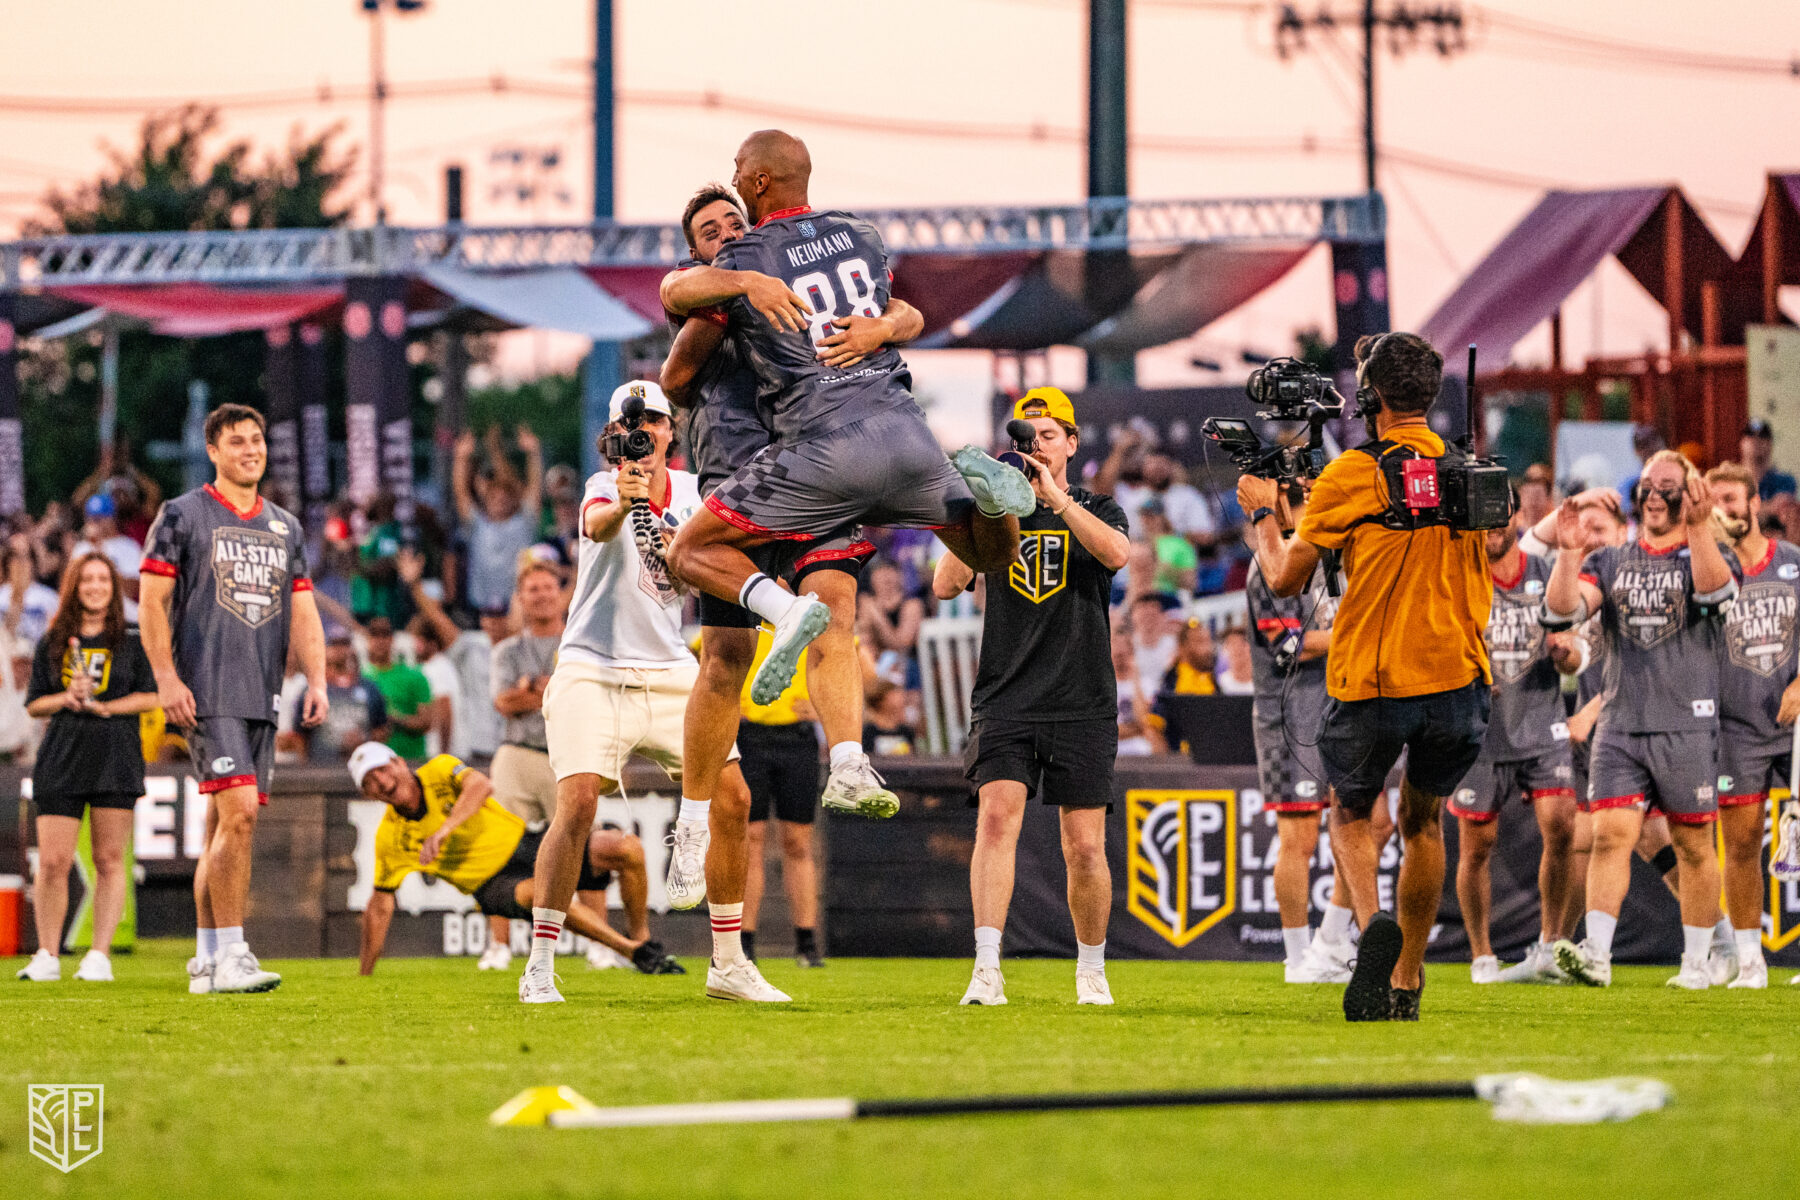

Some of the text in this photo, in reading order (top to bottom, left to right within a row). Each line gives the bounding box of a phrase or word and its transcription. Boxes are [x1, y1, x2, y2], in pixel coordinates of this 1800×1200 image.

[786, 231, 855, 267] NEUMANN
[791, 257, 882, 360] 88
[233, 561, 272, 587] GAME
[1043, 535, 1061, 585] PLL
[1628, 588, 1666, 608] GAME
[1742, 616, 1782, 639] GAME
[1189, 802, 1223, 910] PLL
